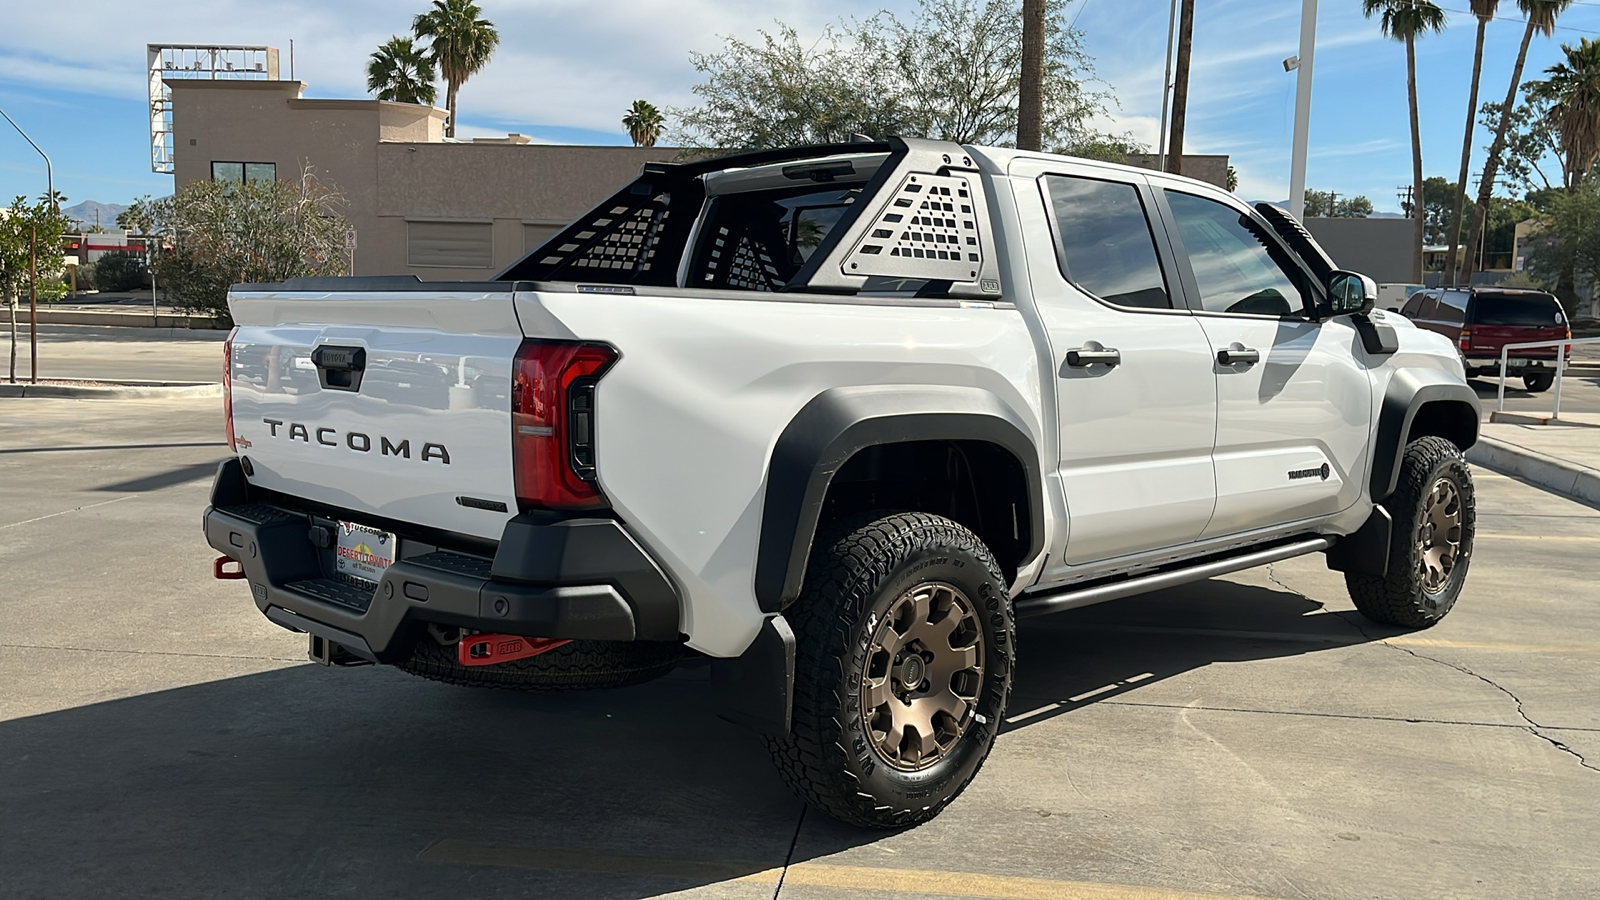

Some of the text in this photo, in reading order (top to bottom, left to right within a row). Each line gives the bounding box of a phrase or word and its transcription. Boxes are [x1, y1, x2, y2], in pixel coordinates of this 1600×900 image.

[322, 352, 347, 364] TOYOTA
[263, 418, 450, 465] TACOMA
[351, 523, 380, 536] TUCSON
[338, 546, 363, 561] DESERT
[358, 563, 376, 574] Tucson
[500, 642, 521, 654] ARB
[847, 610, 879, 779] WRANGLER
